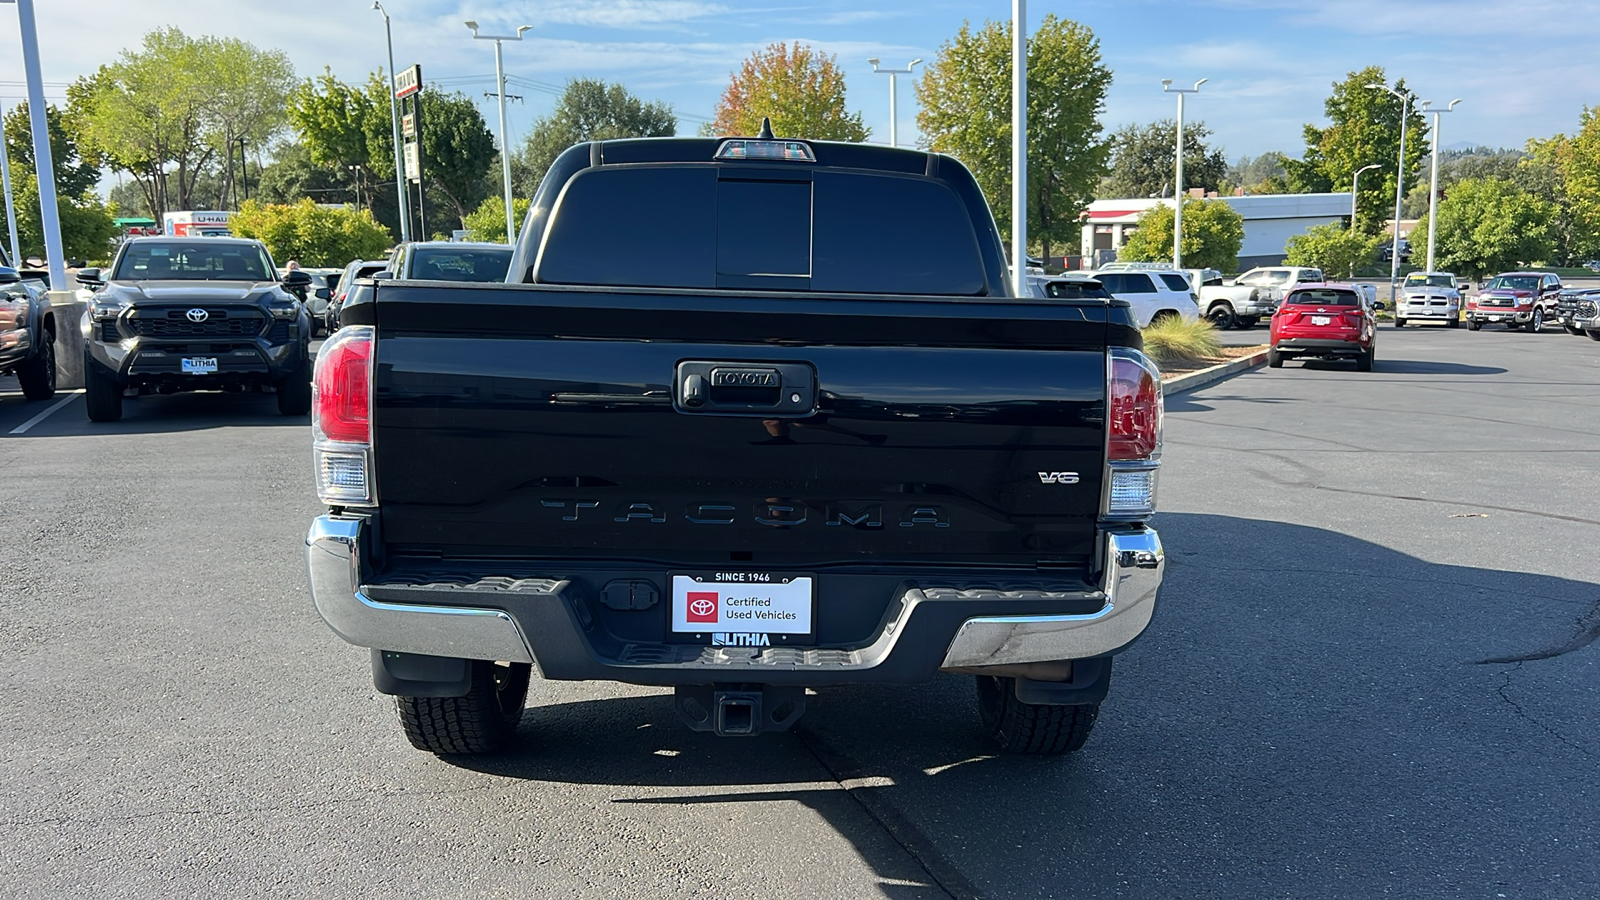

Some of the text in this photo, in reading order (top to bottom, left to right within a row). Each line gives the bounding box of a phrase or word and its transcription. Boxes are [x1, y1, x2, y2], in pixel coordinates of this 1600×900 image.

[716, 372, 777, 386] TOYOTA
[1037, 471, 1080, 484] V6
[540, 500, 950, 528] TACOMA
[715, 572, 770, 582] SINCE 1946
[726, 597, 771, 607] Certified
[726, 610, 797, 620] Used Vehicles
[725, 633, 771, 646] LITHIA
